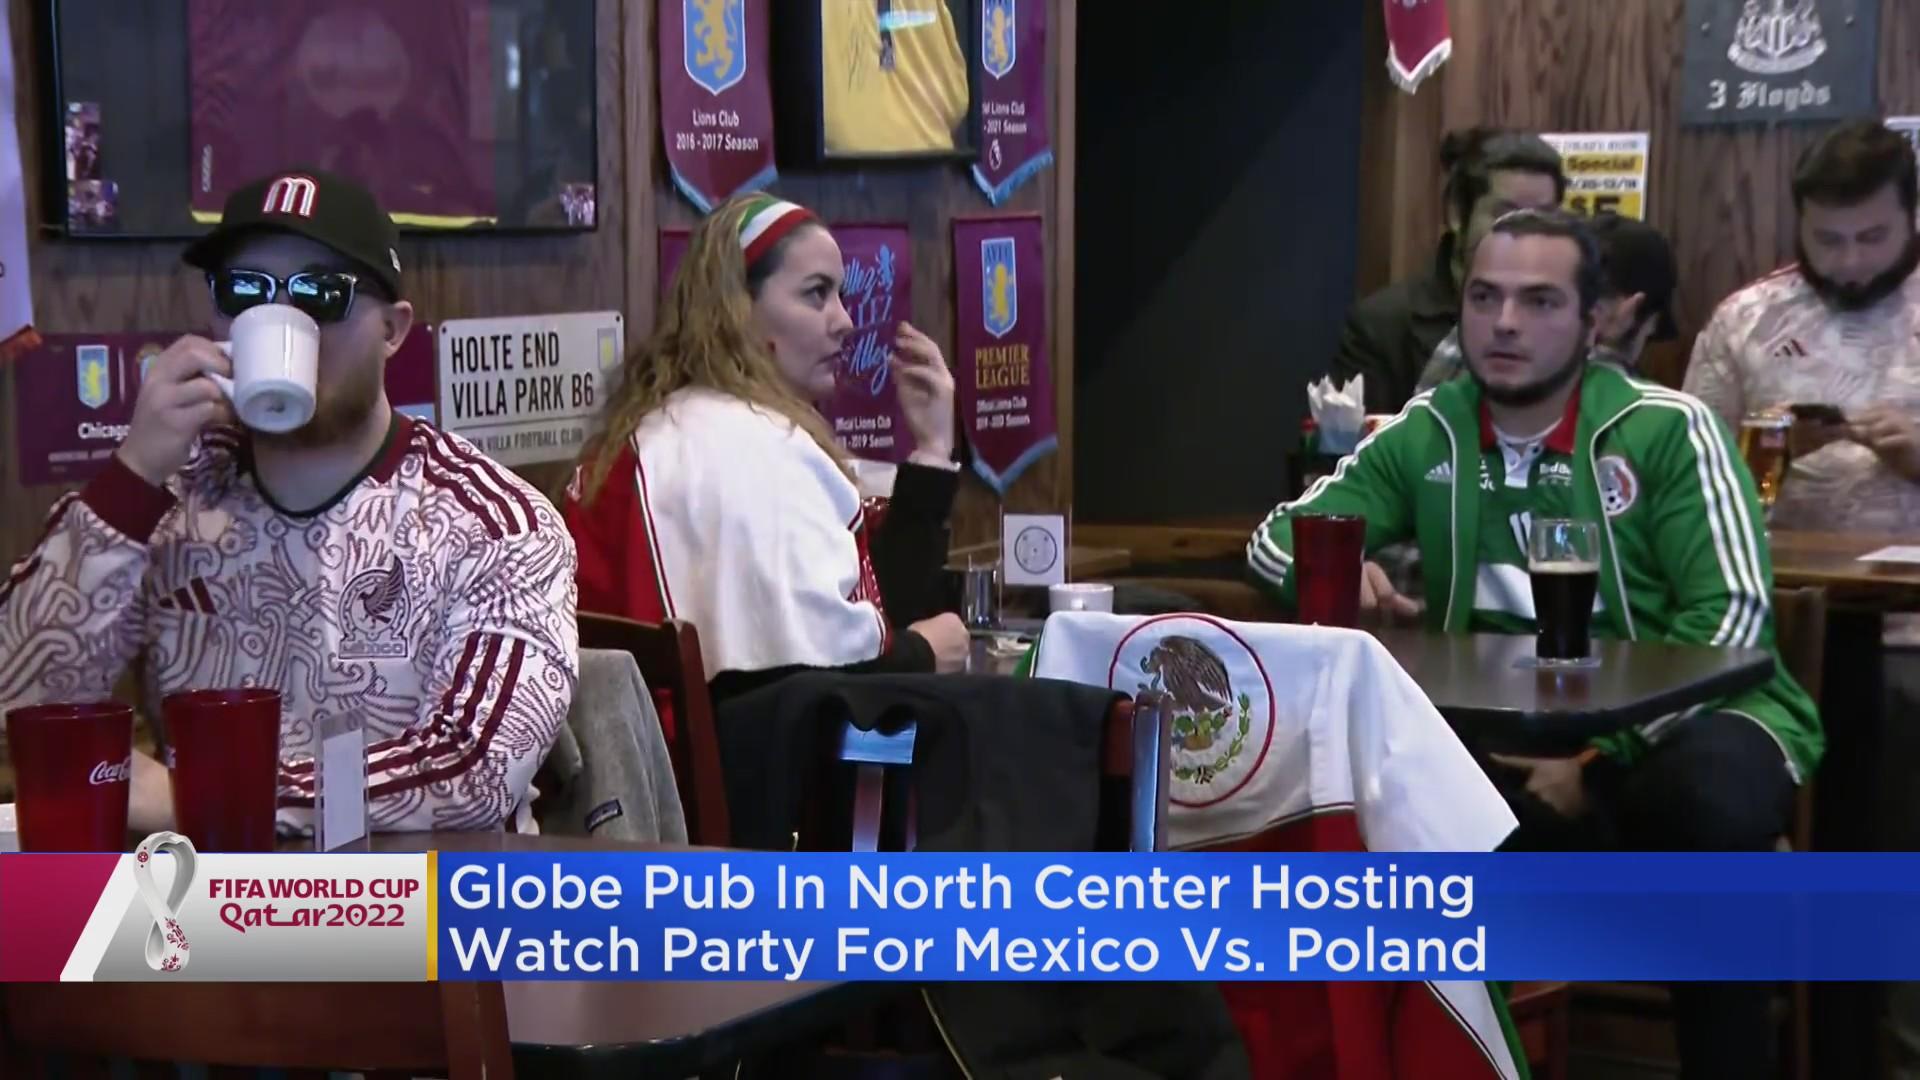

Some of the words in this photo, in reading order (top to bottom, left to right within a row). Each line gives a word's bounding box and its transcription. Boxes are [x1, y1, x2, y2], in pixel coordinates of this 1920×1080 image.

[1735, 79, 1832, 112] Floyds
[692, 109, 717, 127] Lions
[719, 109, 740, 127] Club
[676, 133, 696, 151] 2016
[702, 133, 724, 151] 2017
[725, 133, 759, 151] Season
[452, 335, 513, 374] HOLTE
[523, 332, 560, 369] END
[976, 344, 1030, 368] PREMIER
[976, 365, 1030, 389] LEAGUE
[452, 379, 508, 419] VILLA
[515, 374, 565, 414] PARK
[572, 371, 594, 408] B6
[486, 433, 511, 450] VILLA
[514, 430, 558, 448] FOOTBALL
[560, 427, 583, 445] CLUB
